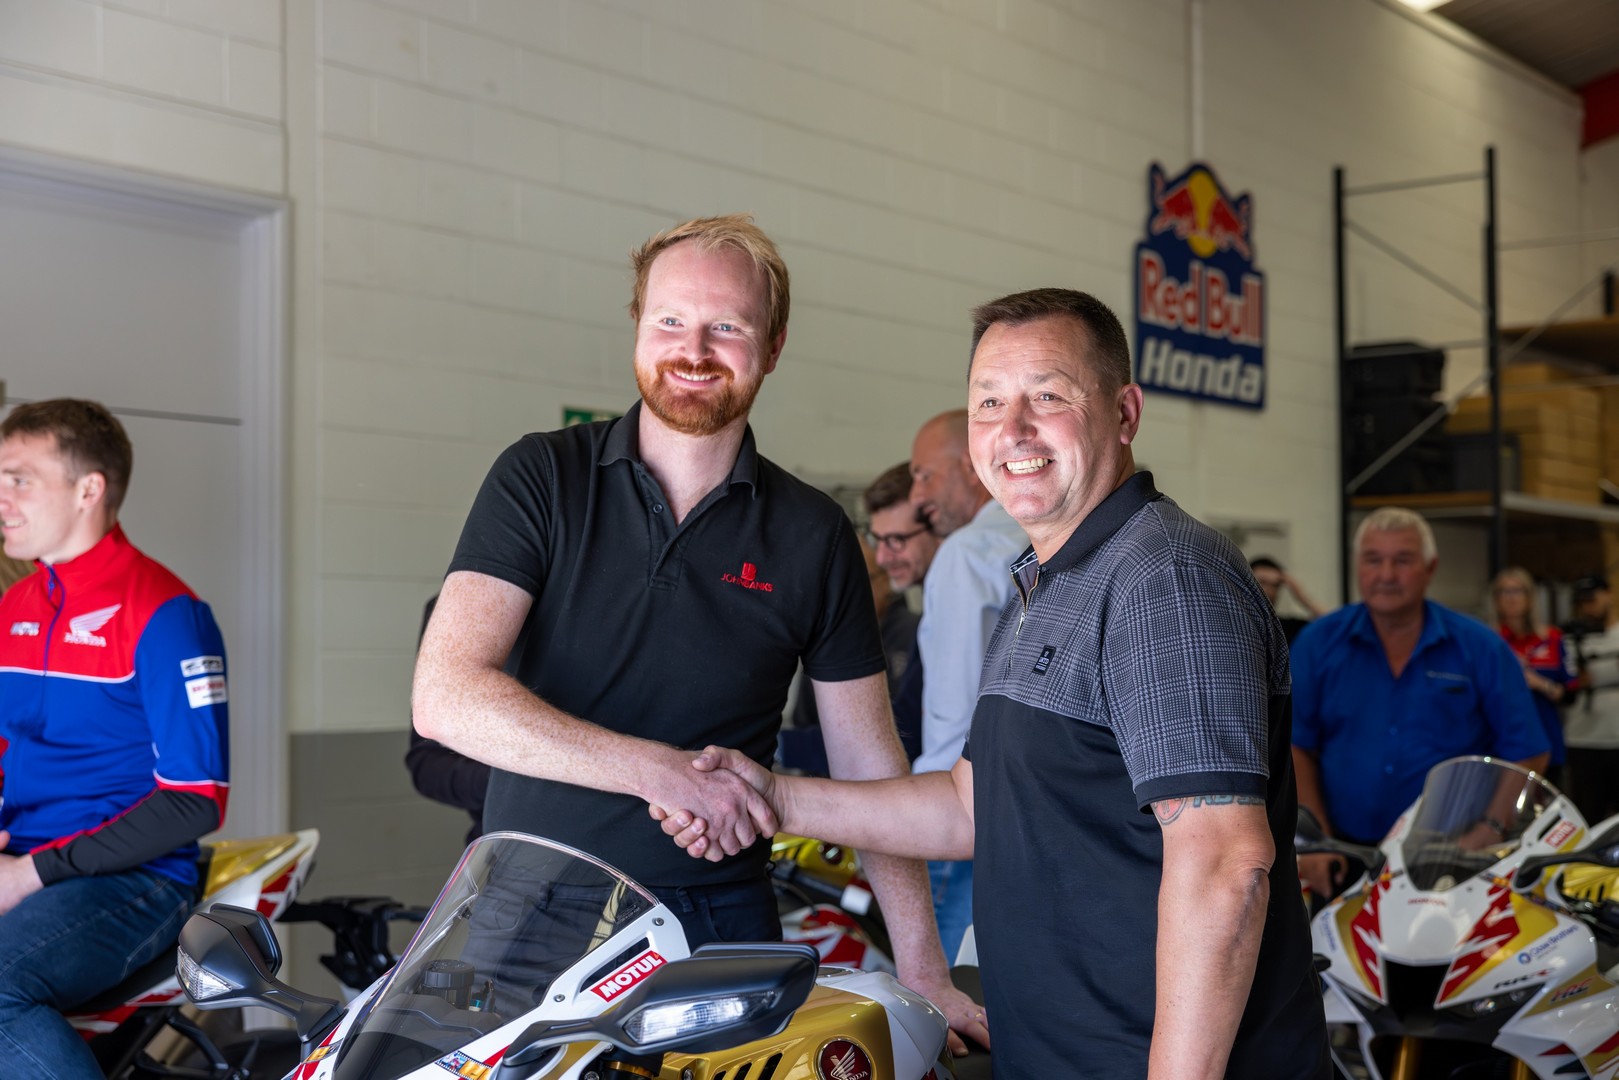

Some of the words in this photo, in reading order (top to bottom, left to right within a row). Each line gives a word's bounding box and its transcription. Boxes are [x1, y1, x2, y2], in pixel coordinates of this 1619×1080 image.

[1138, 250, 1201, 334] Red
[1203, 267, 1262, 346] Bull
[1140, 338, 1263, 403] Honda
[599, 954, 663, 998] MOTUL
